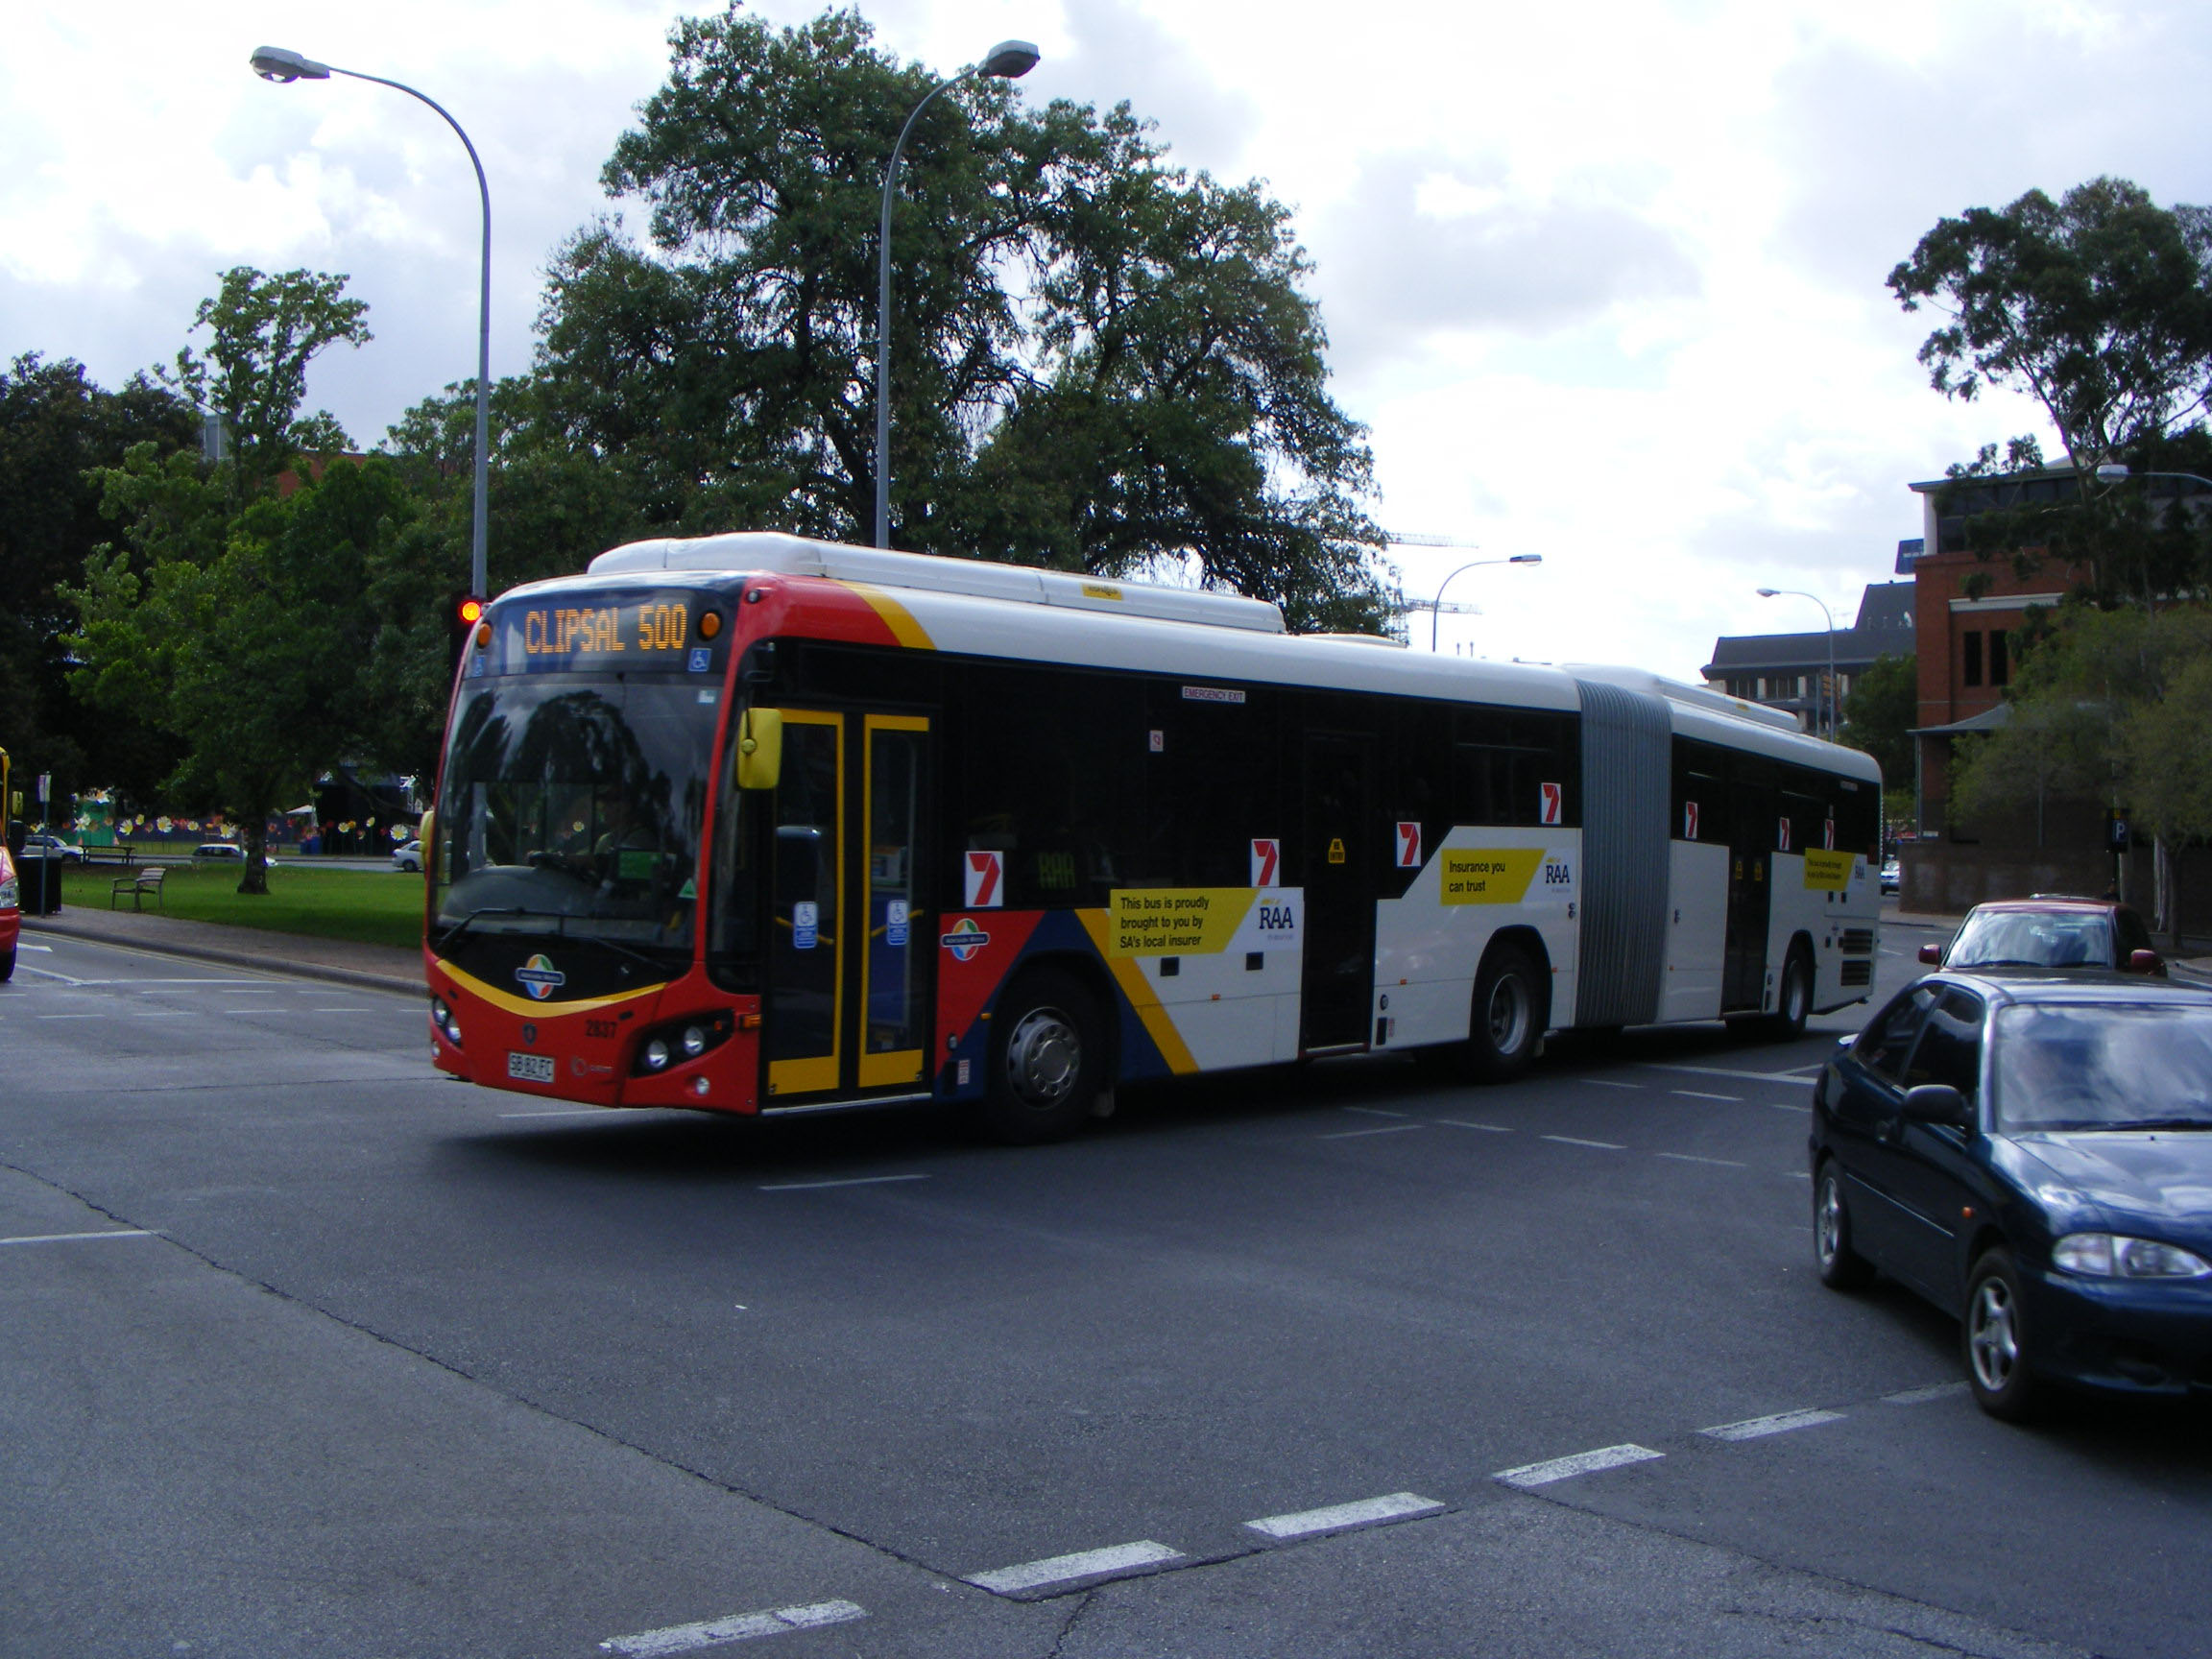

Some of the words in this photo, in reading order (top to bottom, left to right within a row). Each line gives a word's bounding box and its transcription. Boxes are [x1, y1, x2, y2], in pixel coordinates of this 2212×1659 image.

[526, 607, 624, 654] CLIPSAL
[638, 604, 687, 650] 500
[1184, 687, 1227, 701] EMERGENCY
[1228, 690, 1243, 702] EXIT
[1398, 824, 1419, 865] 7
[1253, 840, 1278, 886] 7
[1449, 860, 1489, 873] Insurance
[1491, 862, 1505, 875] you
[968, 853, 1001, 905] 7
[1546, 865, 1570, 884] RAA
[1449, 881, 1463, 893] can
[1466, 880, 1485, 892] trust
[1120, 897, 1142, 909] This
[1143, 897, 1161, 909] bus
[1165, 897, 1172, 908] is
[1175, 896, 1210, 911] proudly
[1120, 916, 1158, 931] brought
[1162, 917, 1170, 927] to
[1173, 919, 1190, 931] you
[1191, 916, 1203, 929] by
[1259, 907, 1293, 929] RAA
[1120, 936, 1142, 949] SA's
[1143, 935, 1166, 948] local
[1168, 935, 1202, 947] insurer
